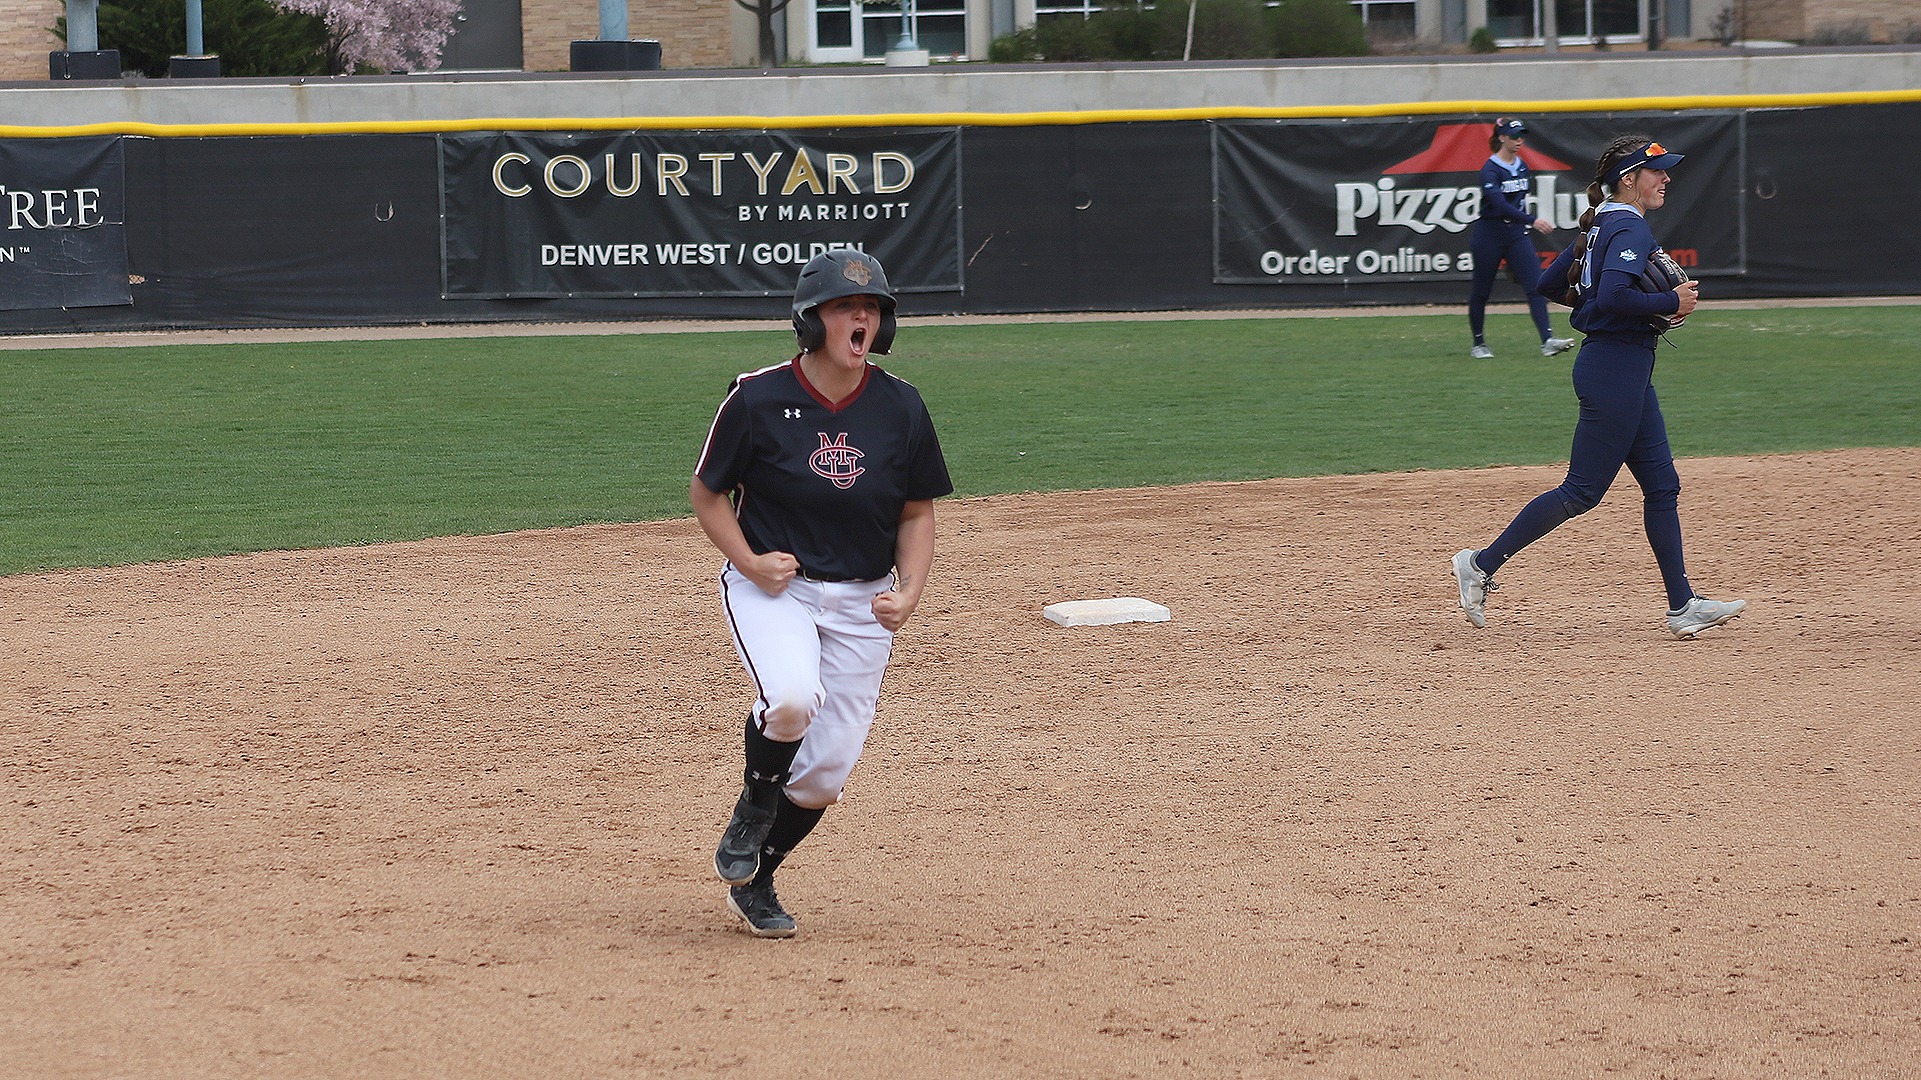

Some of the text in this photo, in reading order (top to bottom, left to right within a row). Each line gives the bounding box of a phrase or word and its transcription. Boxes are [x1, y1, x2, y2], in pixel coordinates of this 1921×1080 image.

[491, 147, 916, 198] COURTYARD
[738, 202, 911, 222] BY MARRIOTT
[1334, 174, 1612, 237] Pizza Hu
[541, 242, 865, 266] DENVER WEST / GOLD
[1260, 250, 1351, 275] Order
[1356, 247, 1450, 274] Online
